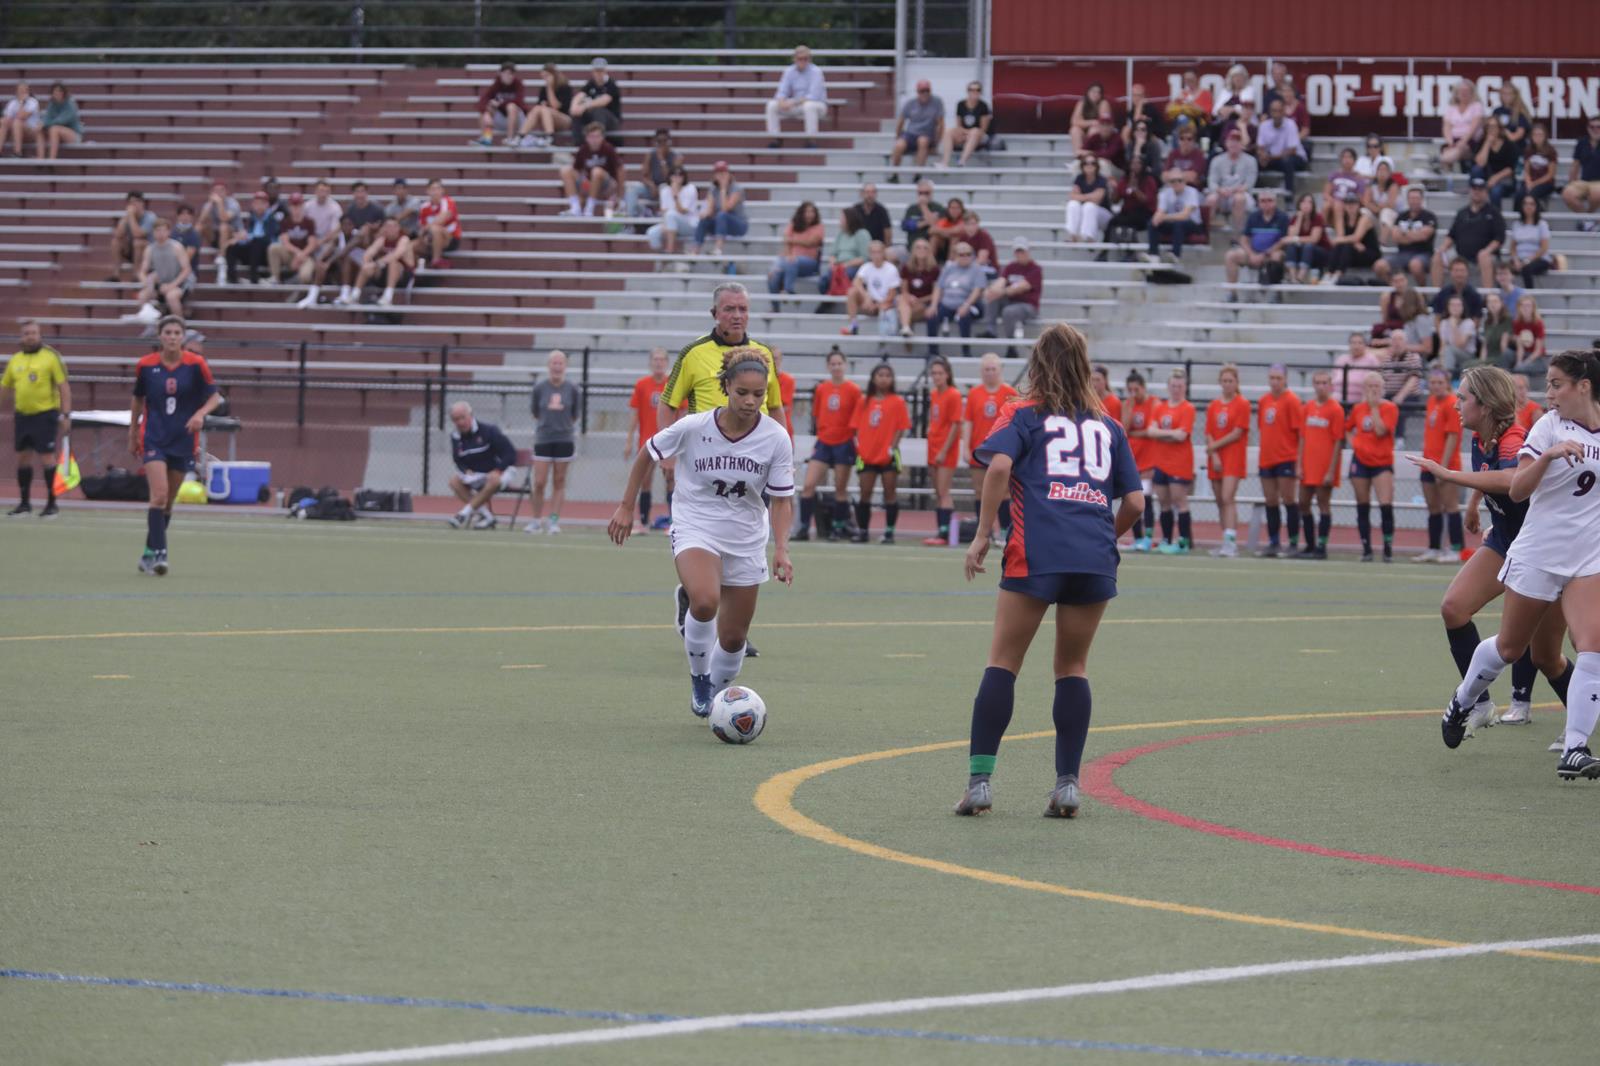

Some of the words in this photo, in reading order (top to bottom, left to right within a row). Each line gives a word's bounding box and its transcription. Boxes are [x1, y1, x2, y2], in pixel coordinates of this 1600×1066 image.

[1306, 74, 1361, 116] OF
[1044, 415, 1112, 481] 20
[712, 479, 748, 498] 24
[1047, 481, 1108, 507] Bullets
[1572, 470, 1596, 496] 9
